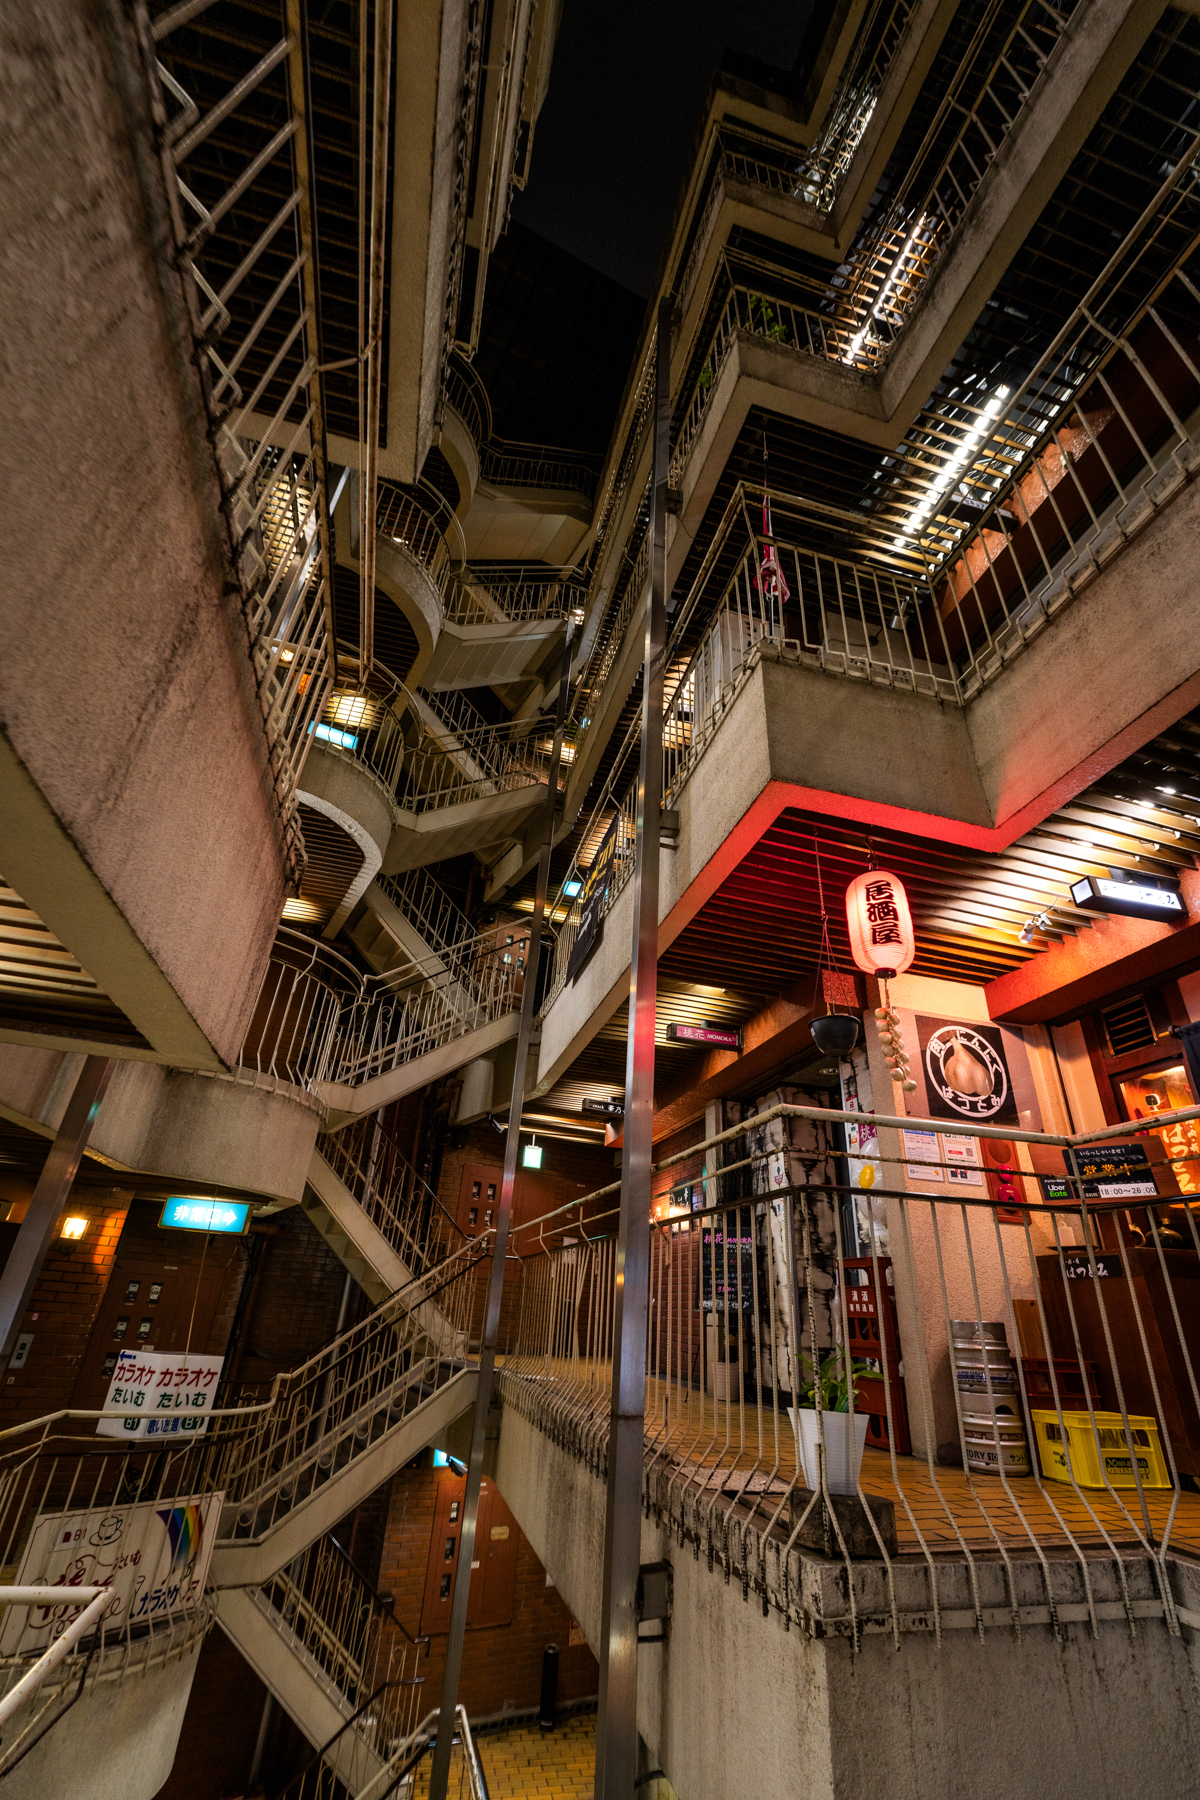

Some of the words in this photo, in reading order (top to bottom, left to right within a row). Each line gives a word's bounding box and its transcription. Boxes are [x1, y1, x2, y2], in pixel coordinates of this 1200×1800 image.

[865, 880, 902, 945] 居酒屋
[682, 1027, 705, 1040] 桃花
[706, 1033, 733, 1043] MOMOKA
[956, 1029, 1003, 1074] にんにく
[941, 1086, 1001, 1113] はつとみ
[174, 1205, 222, 1223] 非常口
[113, 1363, 156, 1386] カラオケ
[156, 1368, 218, 1387] カラオケ
[111, 1387, 145, 1407] たいむ
[156, 1392, 207, 1408] たいむ
[74, 1529, 88, 1541] B1
[137, 1585, 180, 1617] カラオケ
